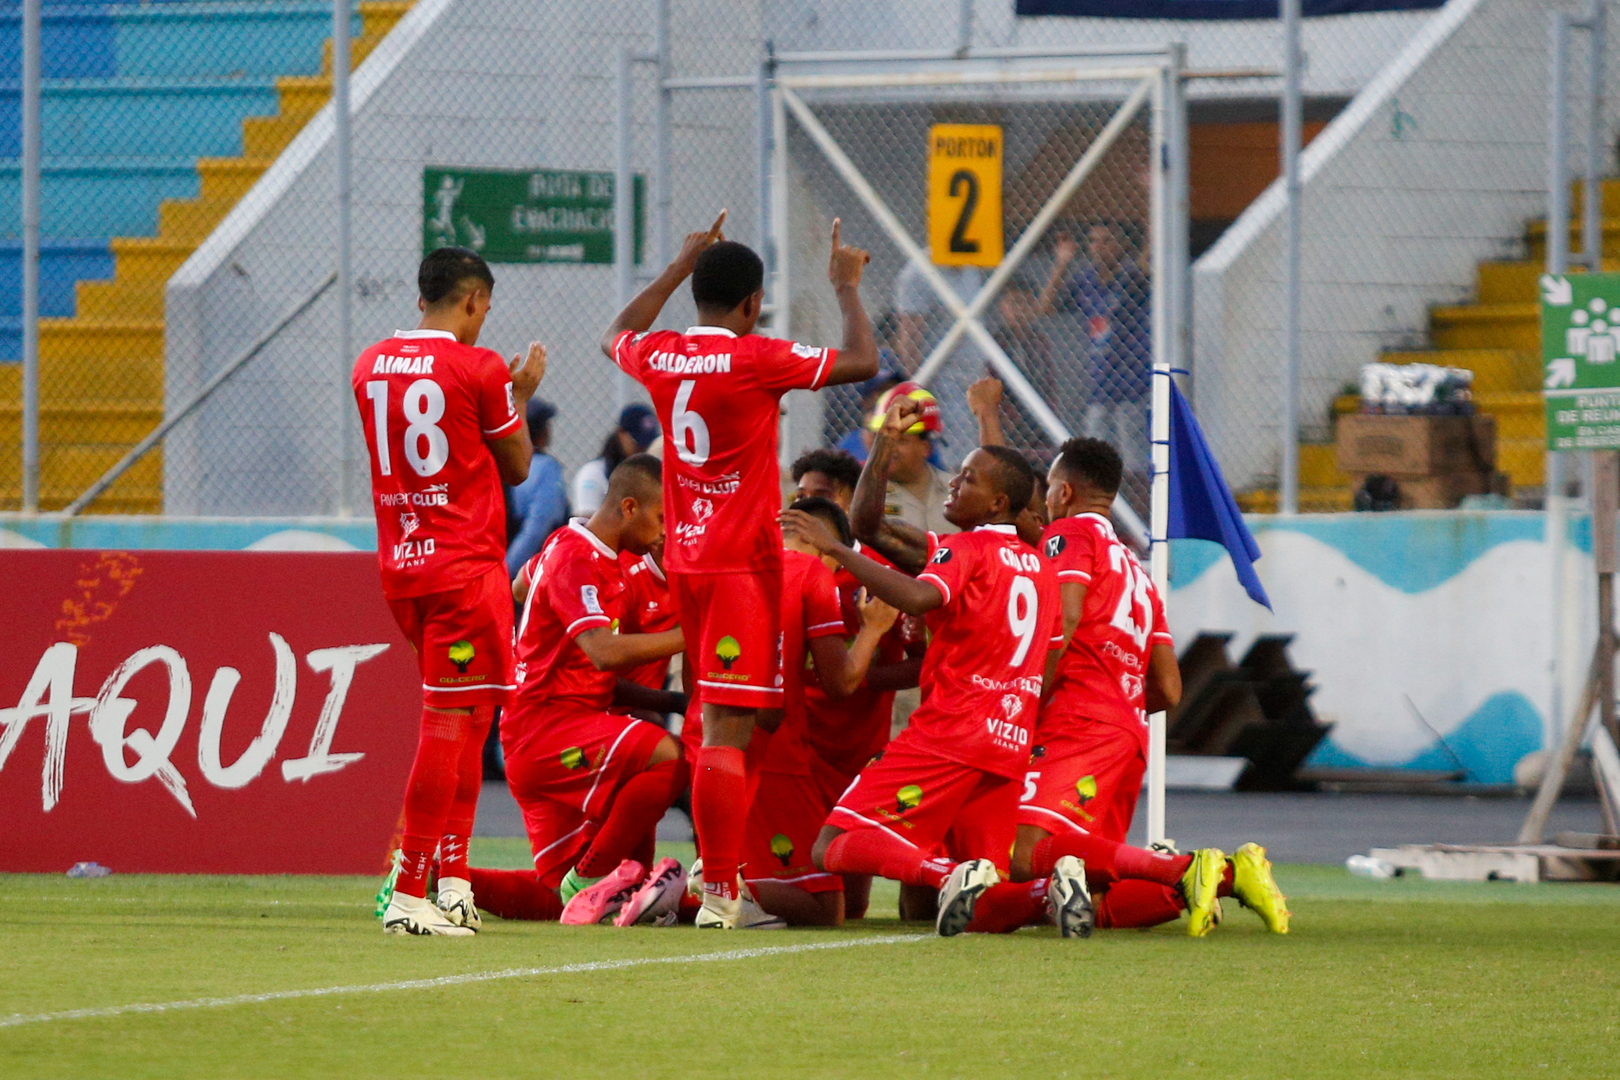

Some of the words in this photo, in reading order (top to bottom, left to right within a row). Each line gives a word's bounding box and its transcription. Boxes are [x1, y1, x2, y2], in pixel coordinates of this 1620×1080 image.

[949, 169, 980, 253] 2
[372, 354, 434, 374] AIMAR
[649, 350, 731, 373] CALDERON
[366, 378, 449, 477] 18
[671, 379, 710, 467] 6
[1576, 395, 1620, 408] PUNT
[412, 493, 449, 506] CLUB
[1007, 574, 1038, 667] 9
[1108, 543, 1153, 653] 25
[0, 631, 391, 819] AQUI
[985, 717, 1028, 745] VIZIO
[1020, 771, 1041, 802] 5
